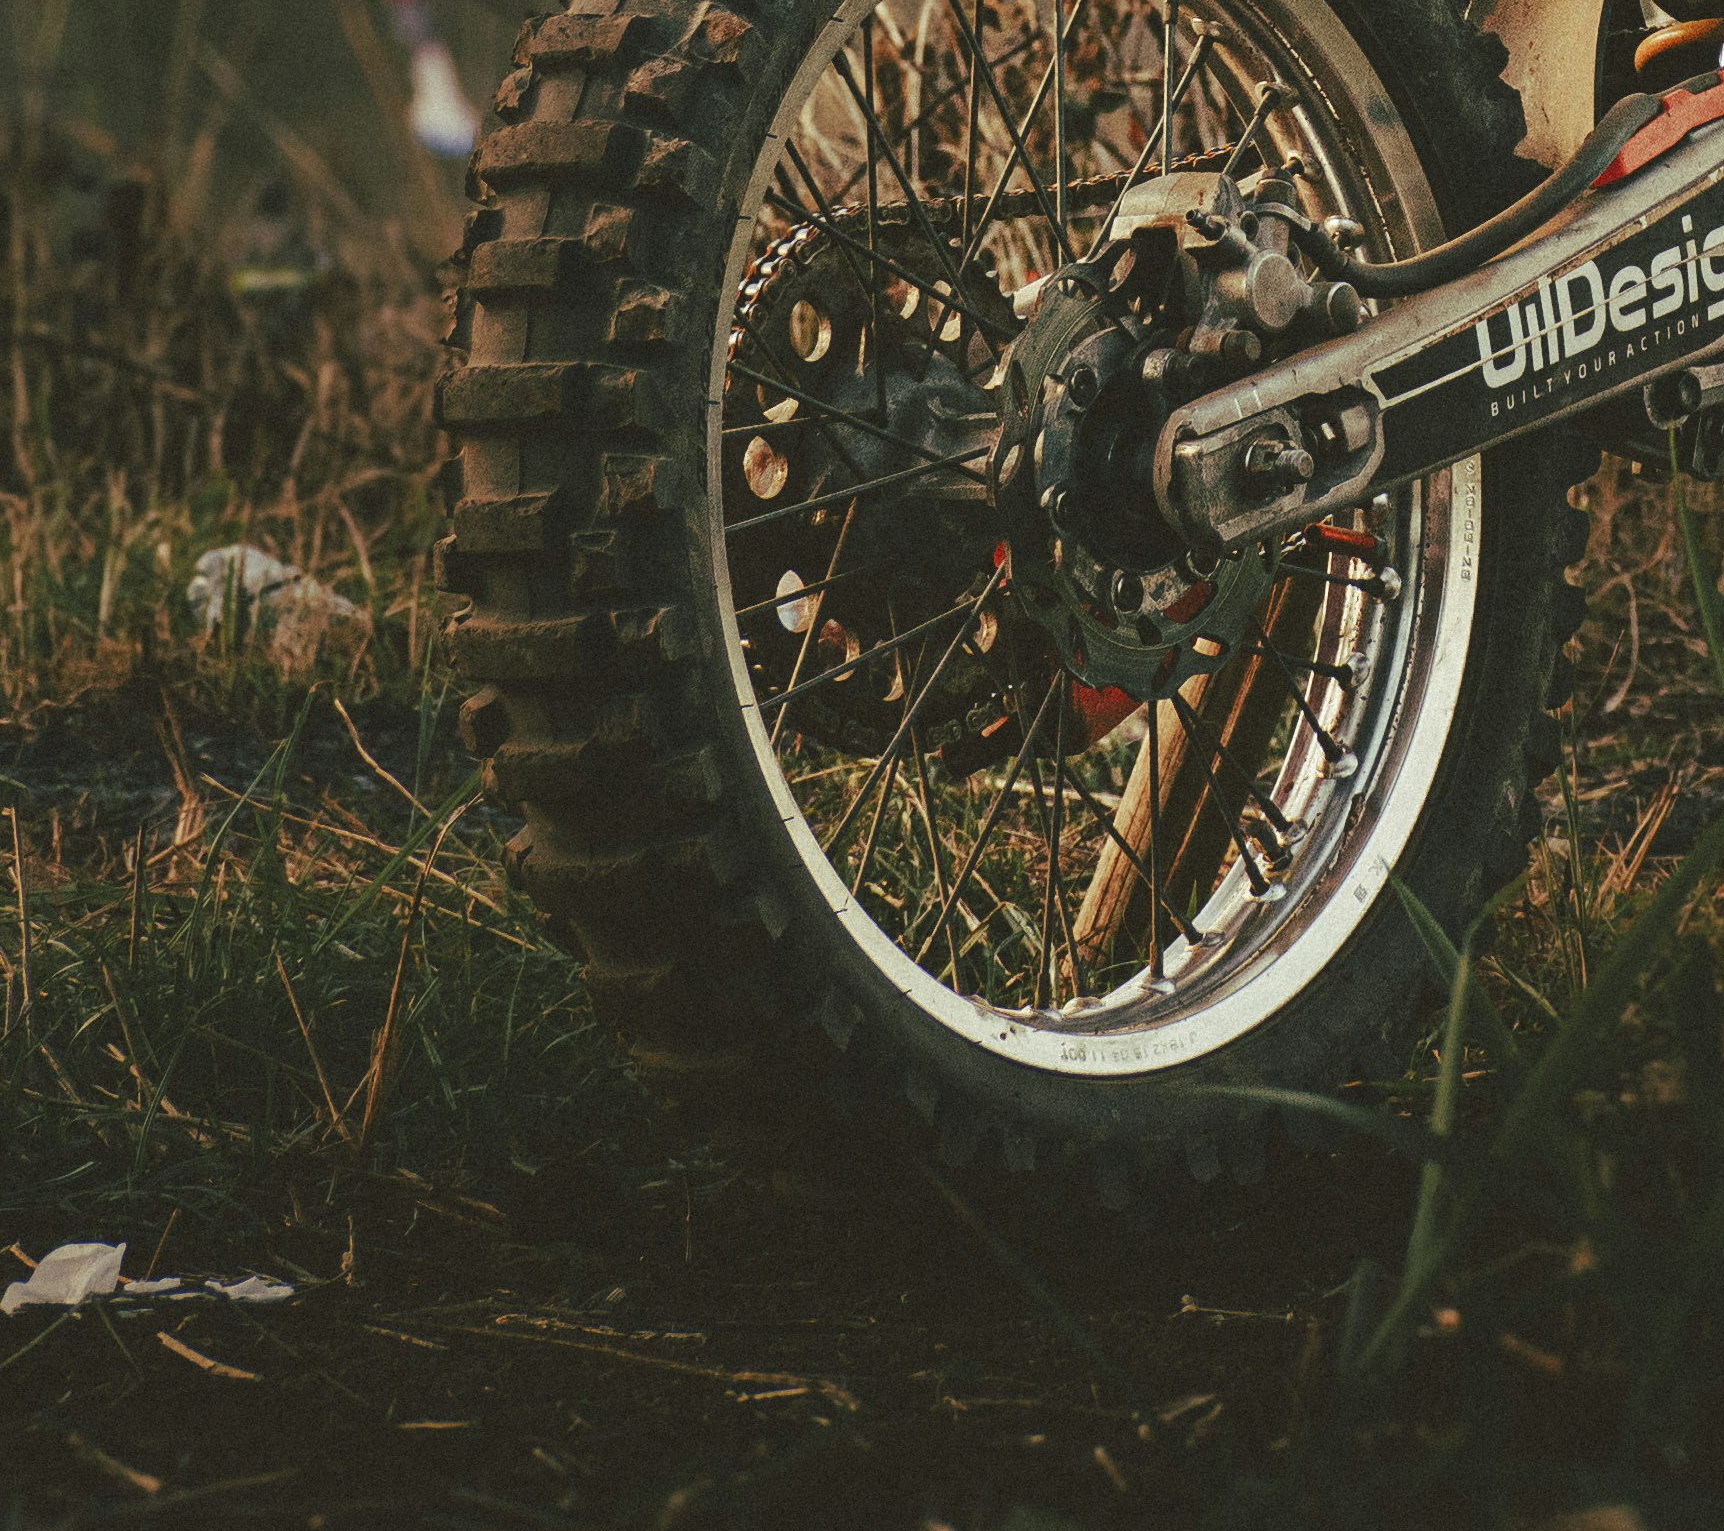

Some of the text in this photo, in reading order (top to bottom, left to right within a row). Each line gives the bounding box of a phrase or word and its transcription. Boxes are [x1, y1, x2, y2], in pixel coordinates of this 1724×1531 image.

[1490, 313, 1700, 418] BUILT YOUR ACTION
